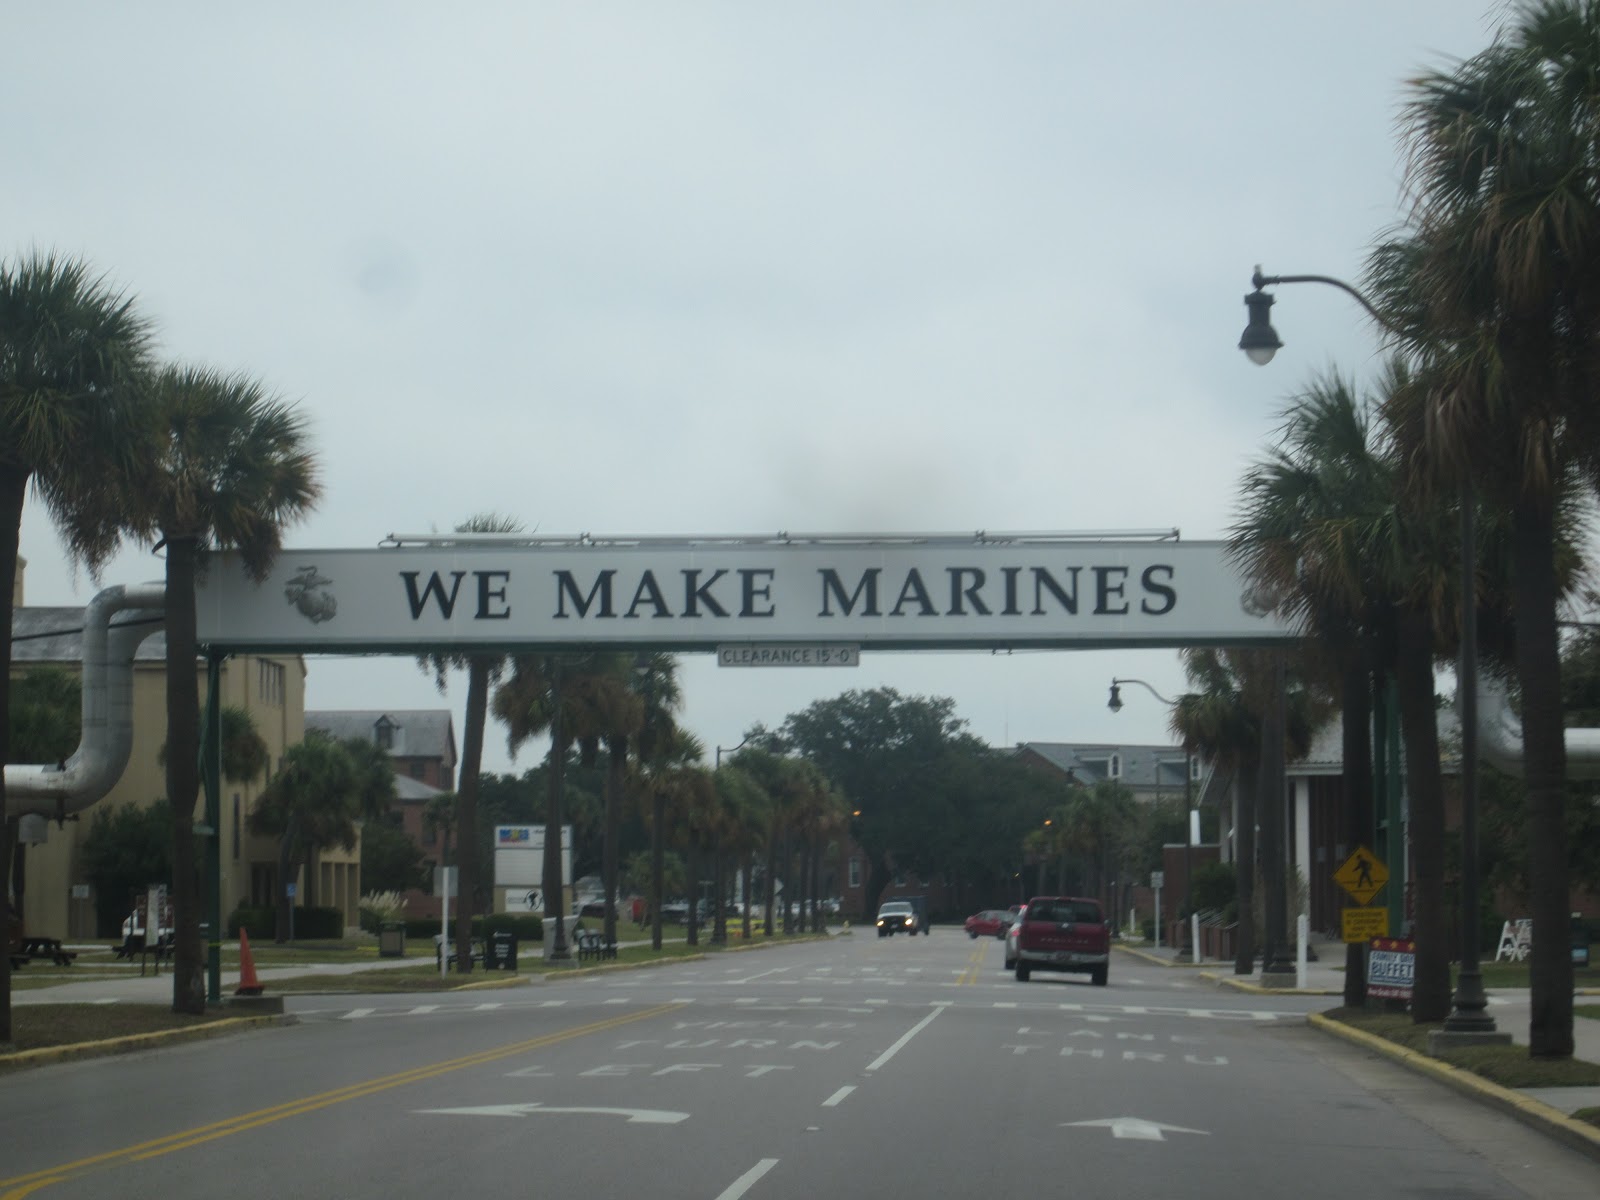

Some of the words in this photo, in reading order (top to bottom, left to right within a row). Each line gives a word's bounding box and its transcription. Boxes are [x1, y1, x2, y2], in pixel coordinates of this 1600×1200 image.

[399, 569, 512, 621] WE
[552, 568, 776, 620] MAKE
[817, 564, 1178, 618] MARINES
[721, 648, 811, 663] CLEARANCE
[616, 1038, 842, 1050] TURN
[503, 1062, 796, 1079] LEFT
